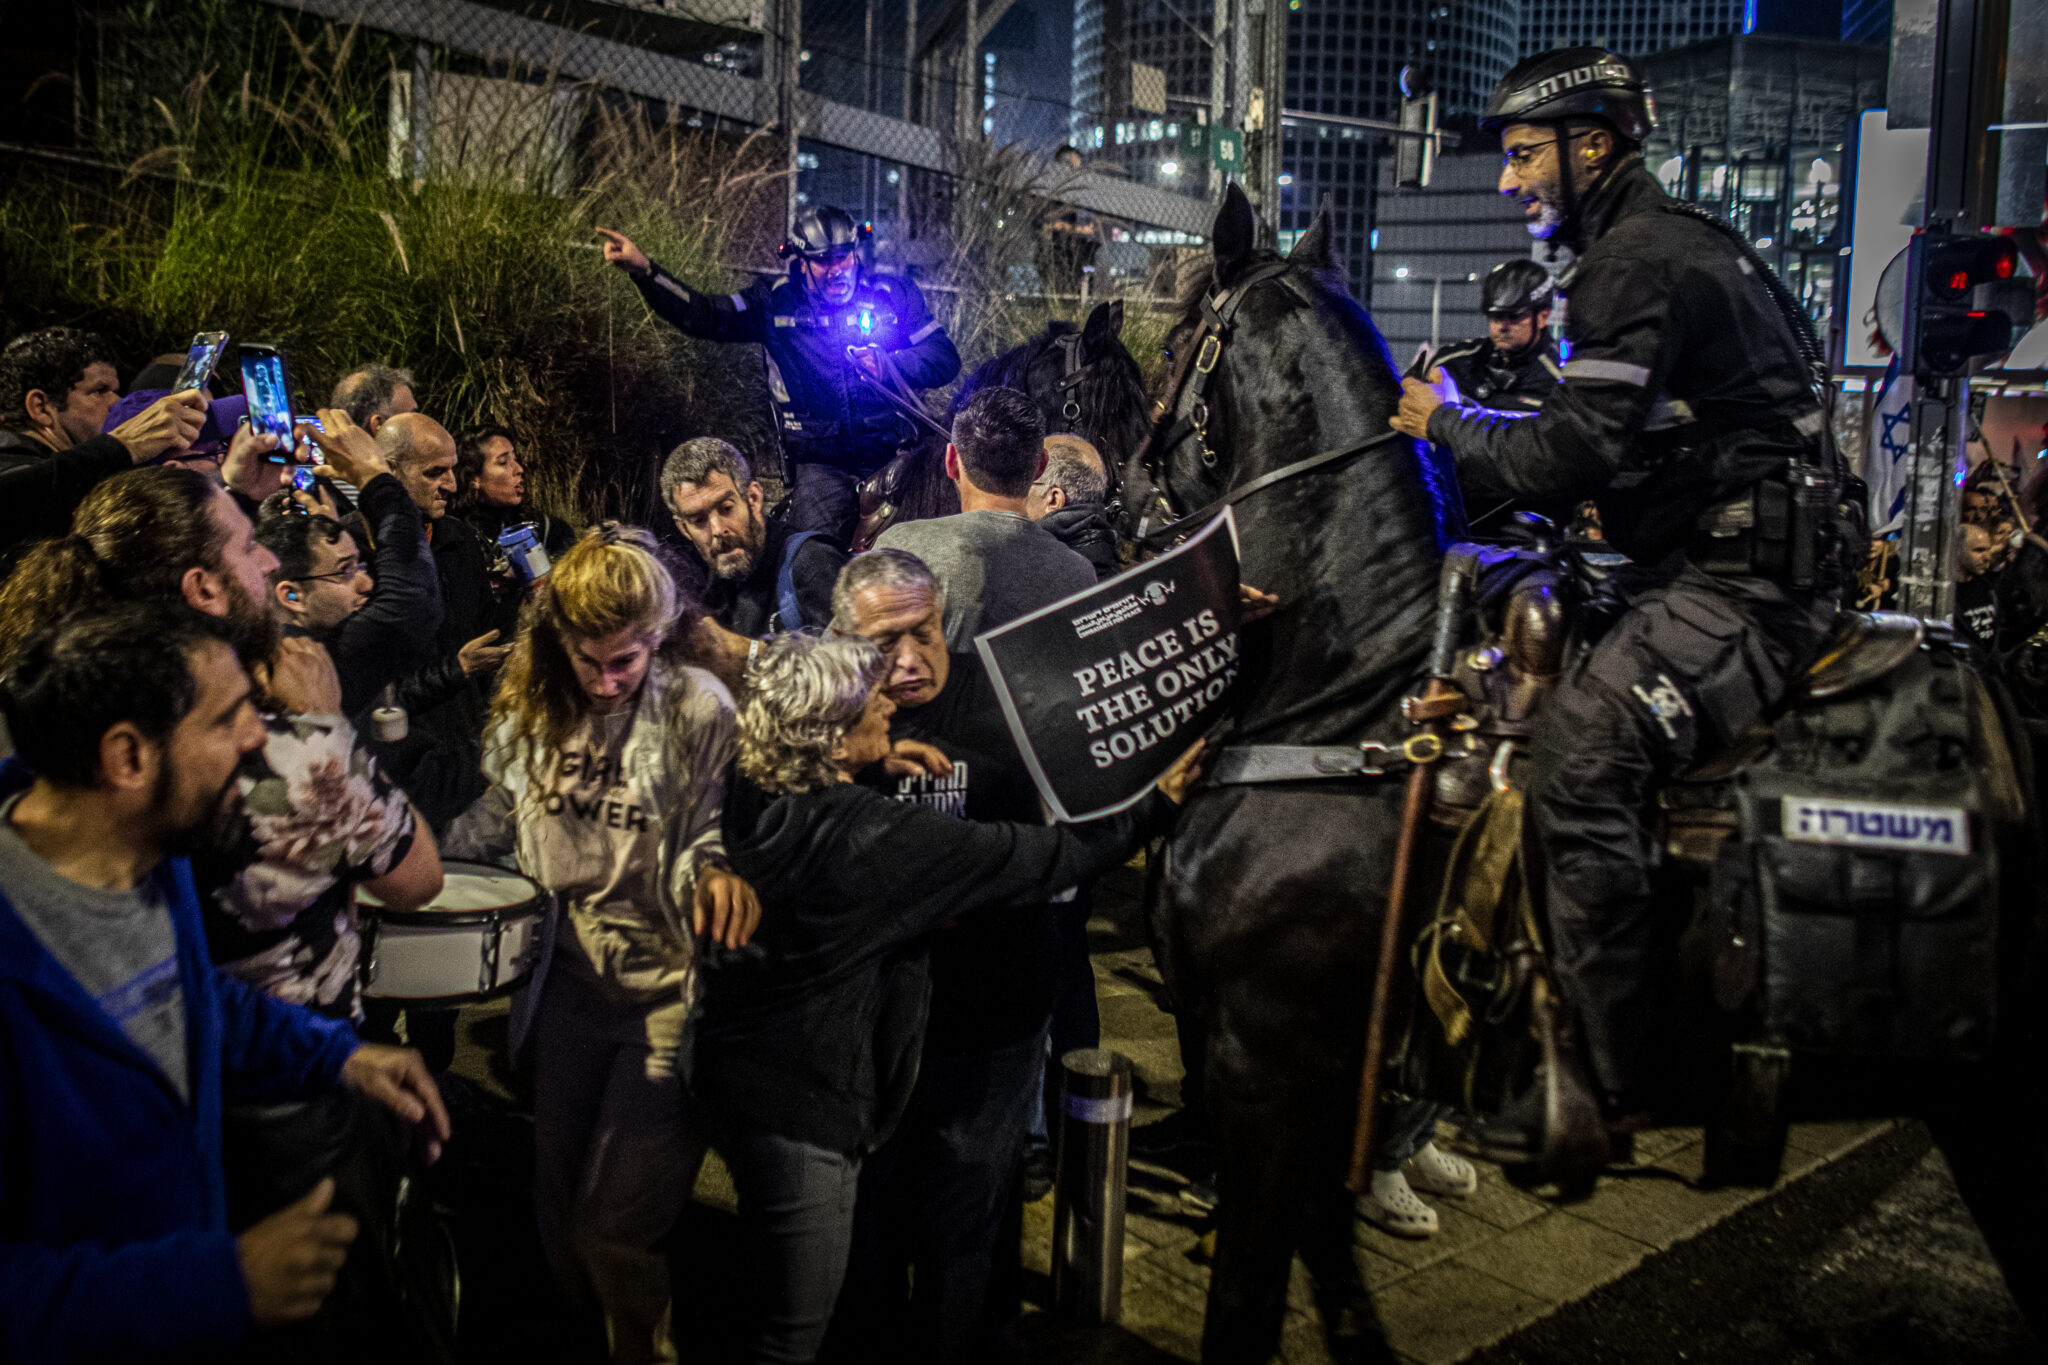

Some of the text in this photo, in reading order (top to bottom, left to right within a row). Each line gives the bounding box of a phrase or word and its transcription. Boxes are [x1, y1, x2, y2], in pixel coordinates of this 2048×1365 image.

[1537, 63, 1632, 98] משטרה
[1220, 139, 1235, 161] 58
[1073, 628, 1184, 697] PEACE
[1183, 608, 1220, 646] IS
[1076, 632, 1239, 734] THE ONLY
[545, 792, 648, 832] OWER
[1799, 807, 1953, 844] משטרה
